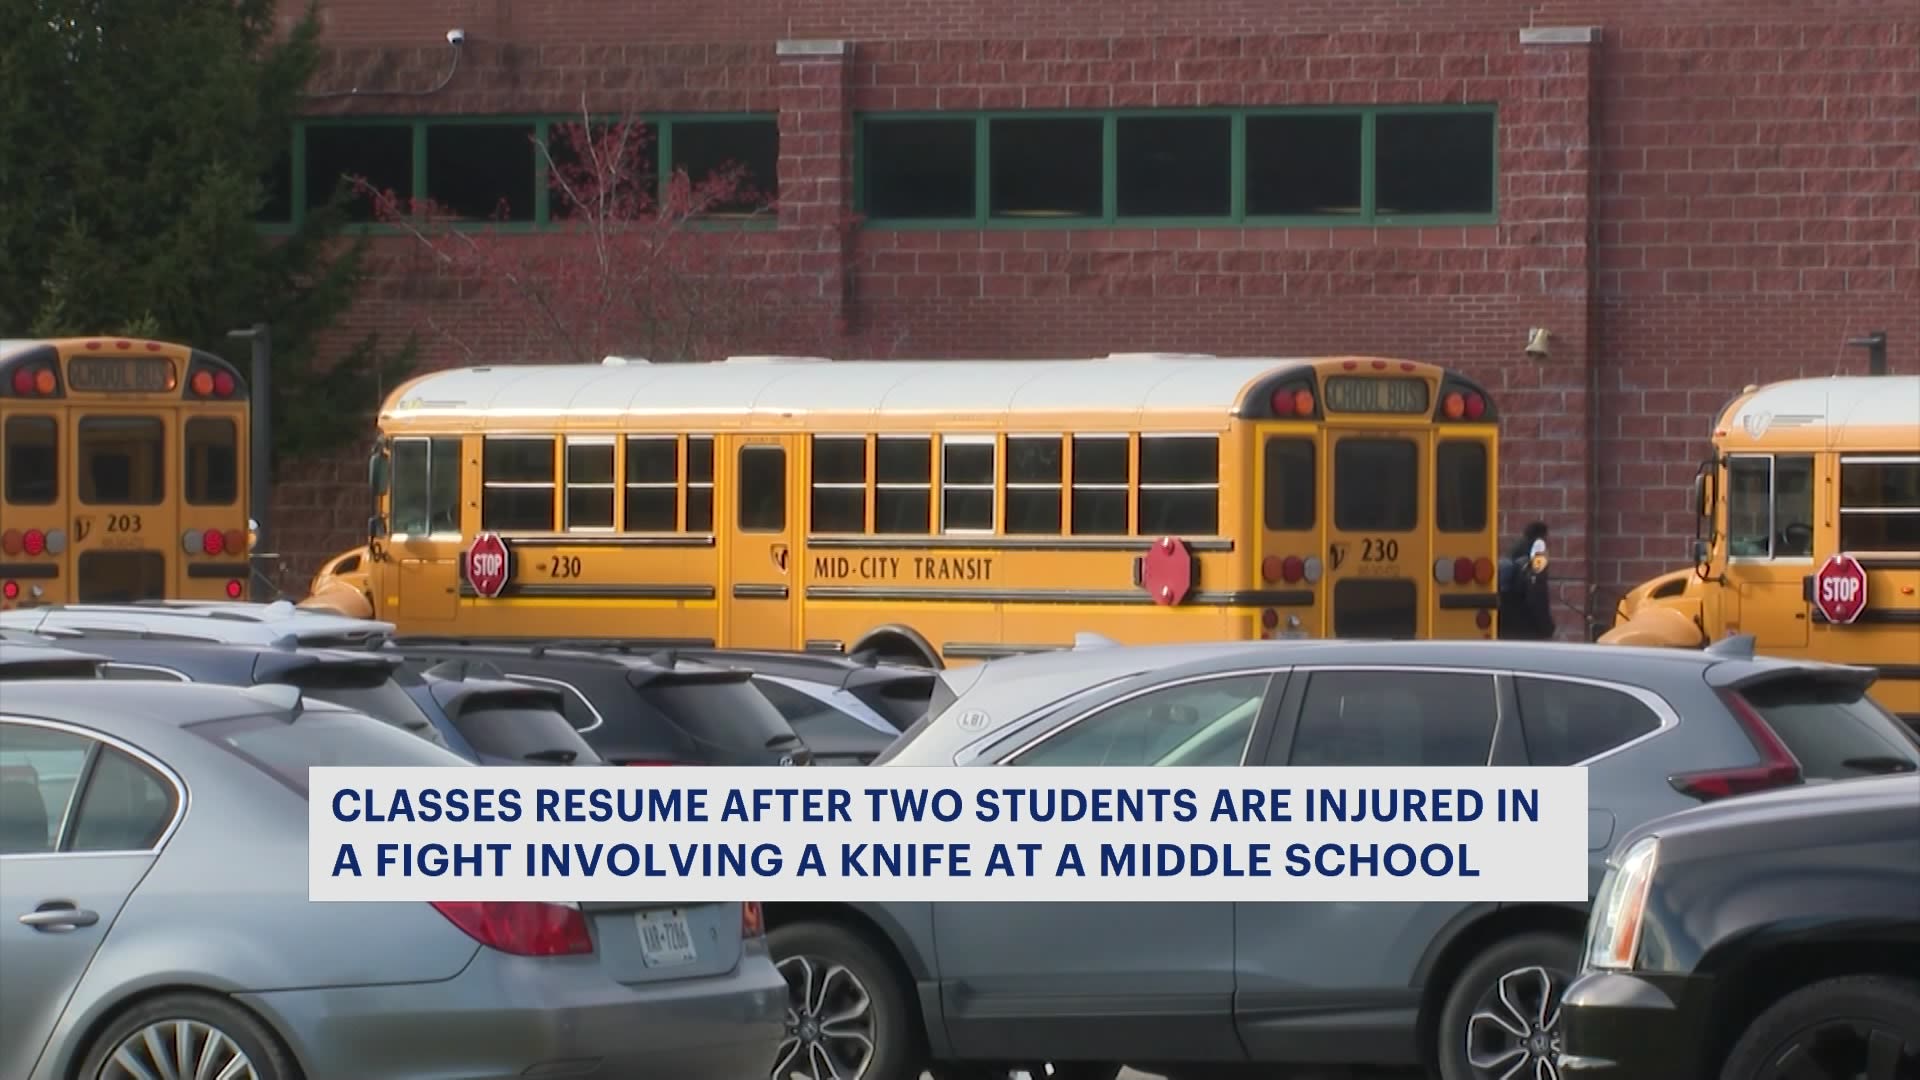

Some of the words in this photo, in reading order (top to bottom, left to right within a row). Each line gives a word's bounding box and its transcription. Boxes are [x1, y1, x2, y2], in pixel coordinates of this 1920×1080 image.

[1328, 379, 1384, 410] SCHOOL
[1388, 379, 1417, 410] BUS
[106, 514, 142, 533] 203
[1361, 538, 1399, 562] 230
[473, 553, 501, 577] STOP
[551, 556, 581, 578] 230
[814, 557, 900, 580] MID-CITY
[914, 557, 993, 581] TRANSIT
[1822, 577, 1860, 602] STOP
